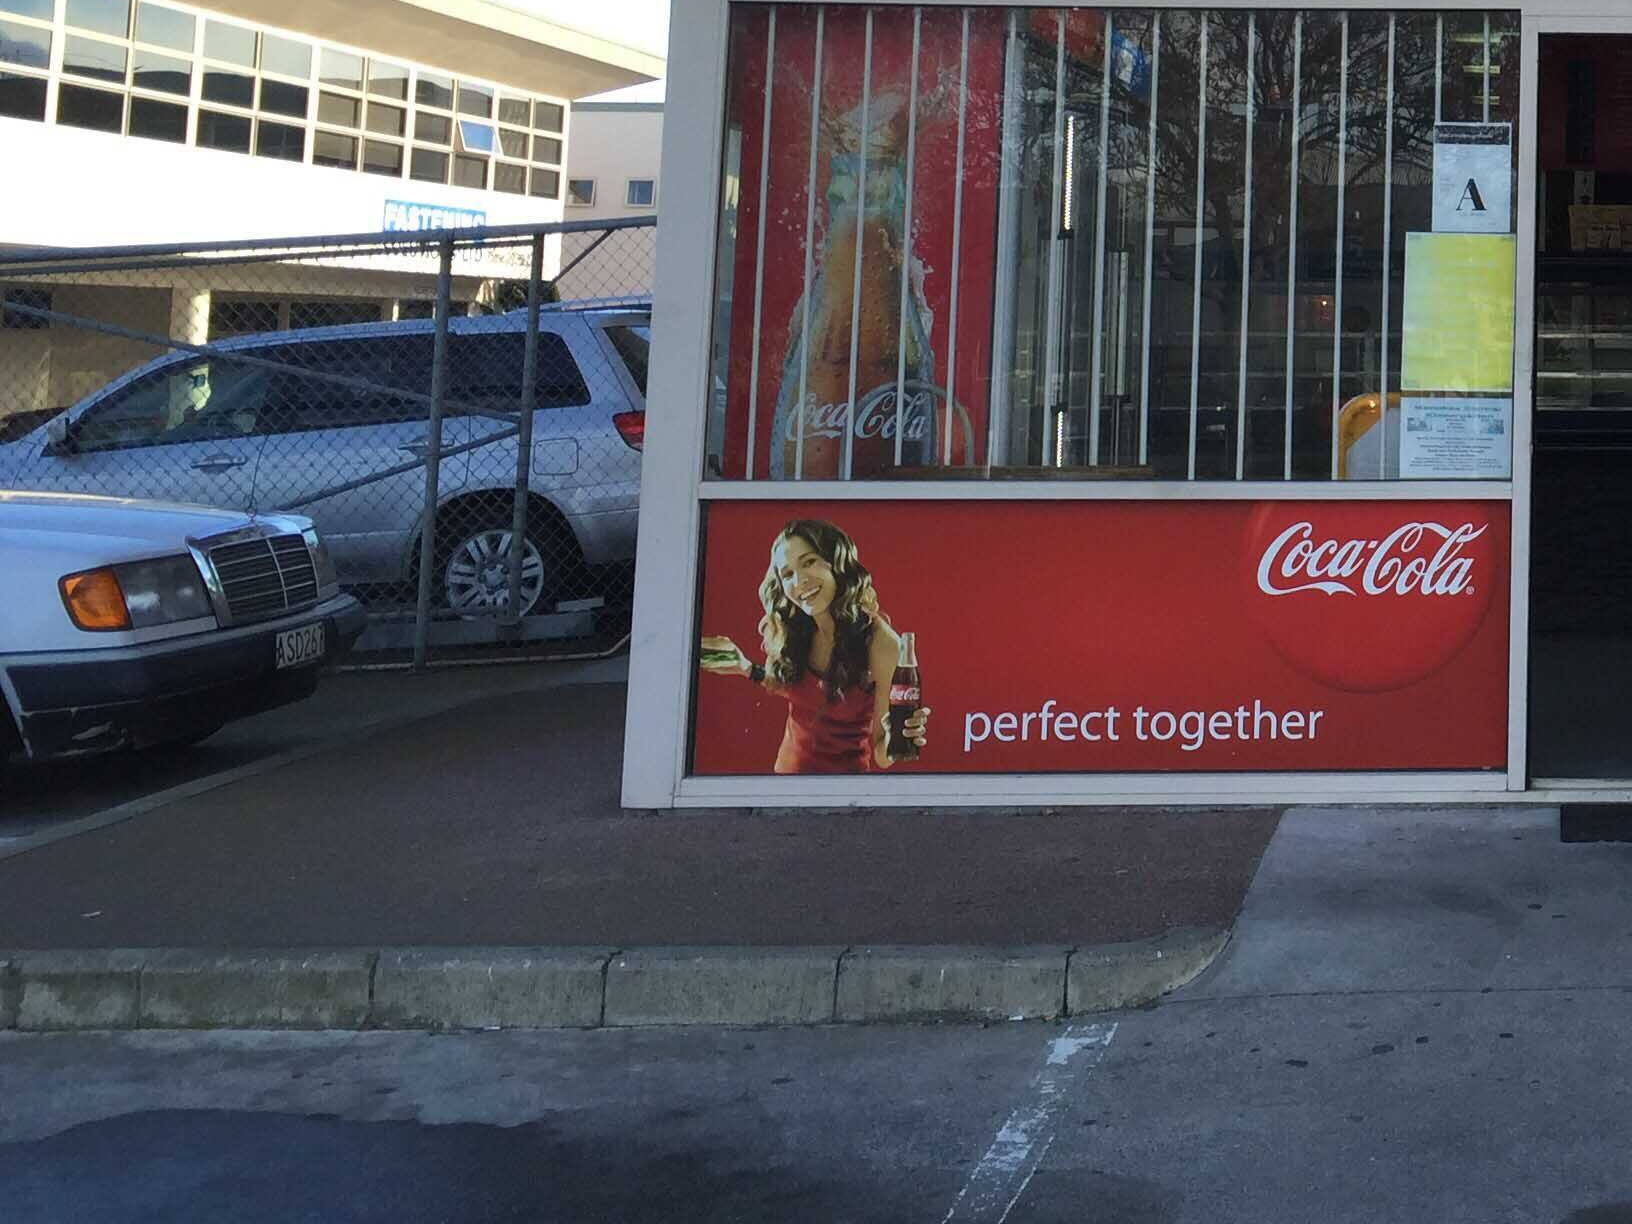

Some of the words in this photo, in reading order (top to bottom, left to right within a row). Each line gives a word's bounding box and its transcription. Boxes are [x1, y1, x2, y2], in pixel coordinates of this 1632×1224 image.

[1456, 178, 1488, 211] A
[784, 391, 928, 441] CocaCola
[1257, 521, 1489, 596] Coca-Cola
[963, 700, 1121, 752] perfect
[1132, 699, 1324, 752] together
